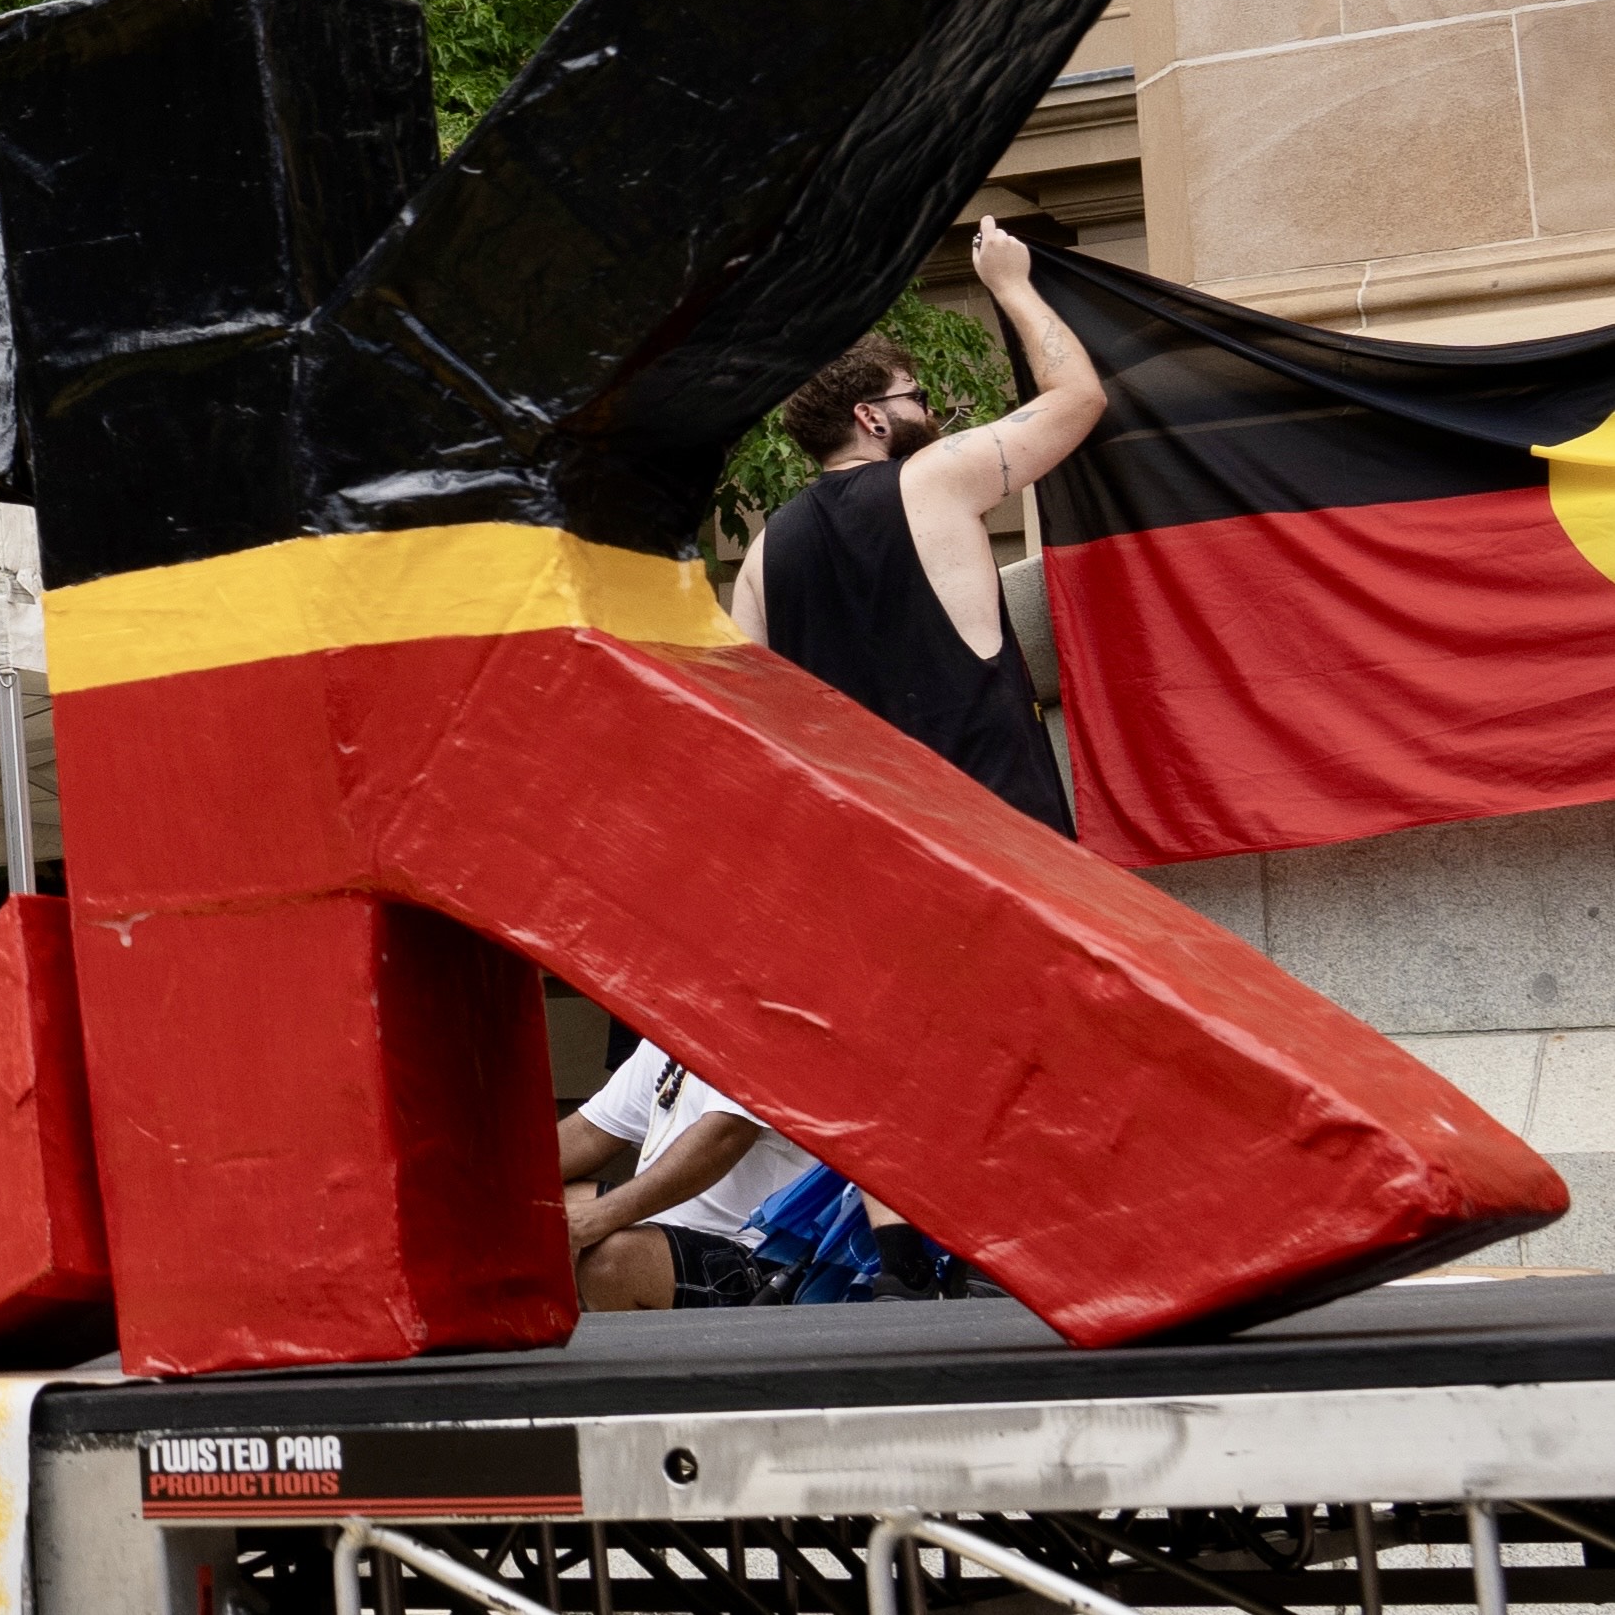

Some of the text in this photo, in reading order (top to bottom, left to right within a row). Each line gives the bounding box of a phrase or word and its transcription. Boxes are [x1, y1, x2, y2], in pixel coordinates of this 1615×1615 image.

[149, 1435, 342, 1473] TWISTED PAIR
[150, 1471, 339, 1497] PRODUCTIONS
